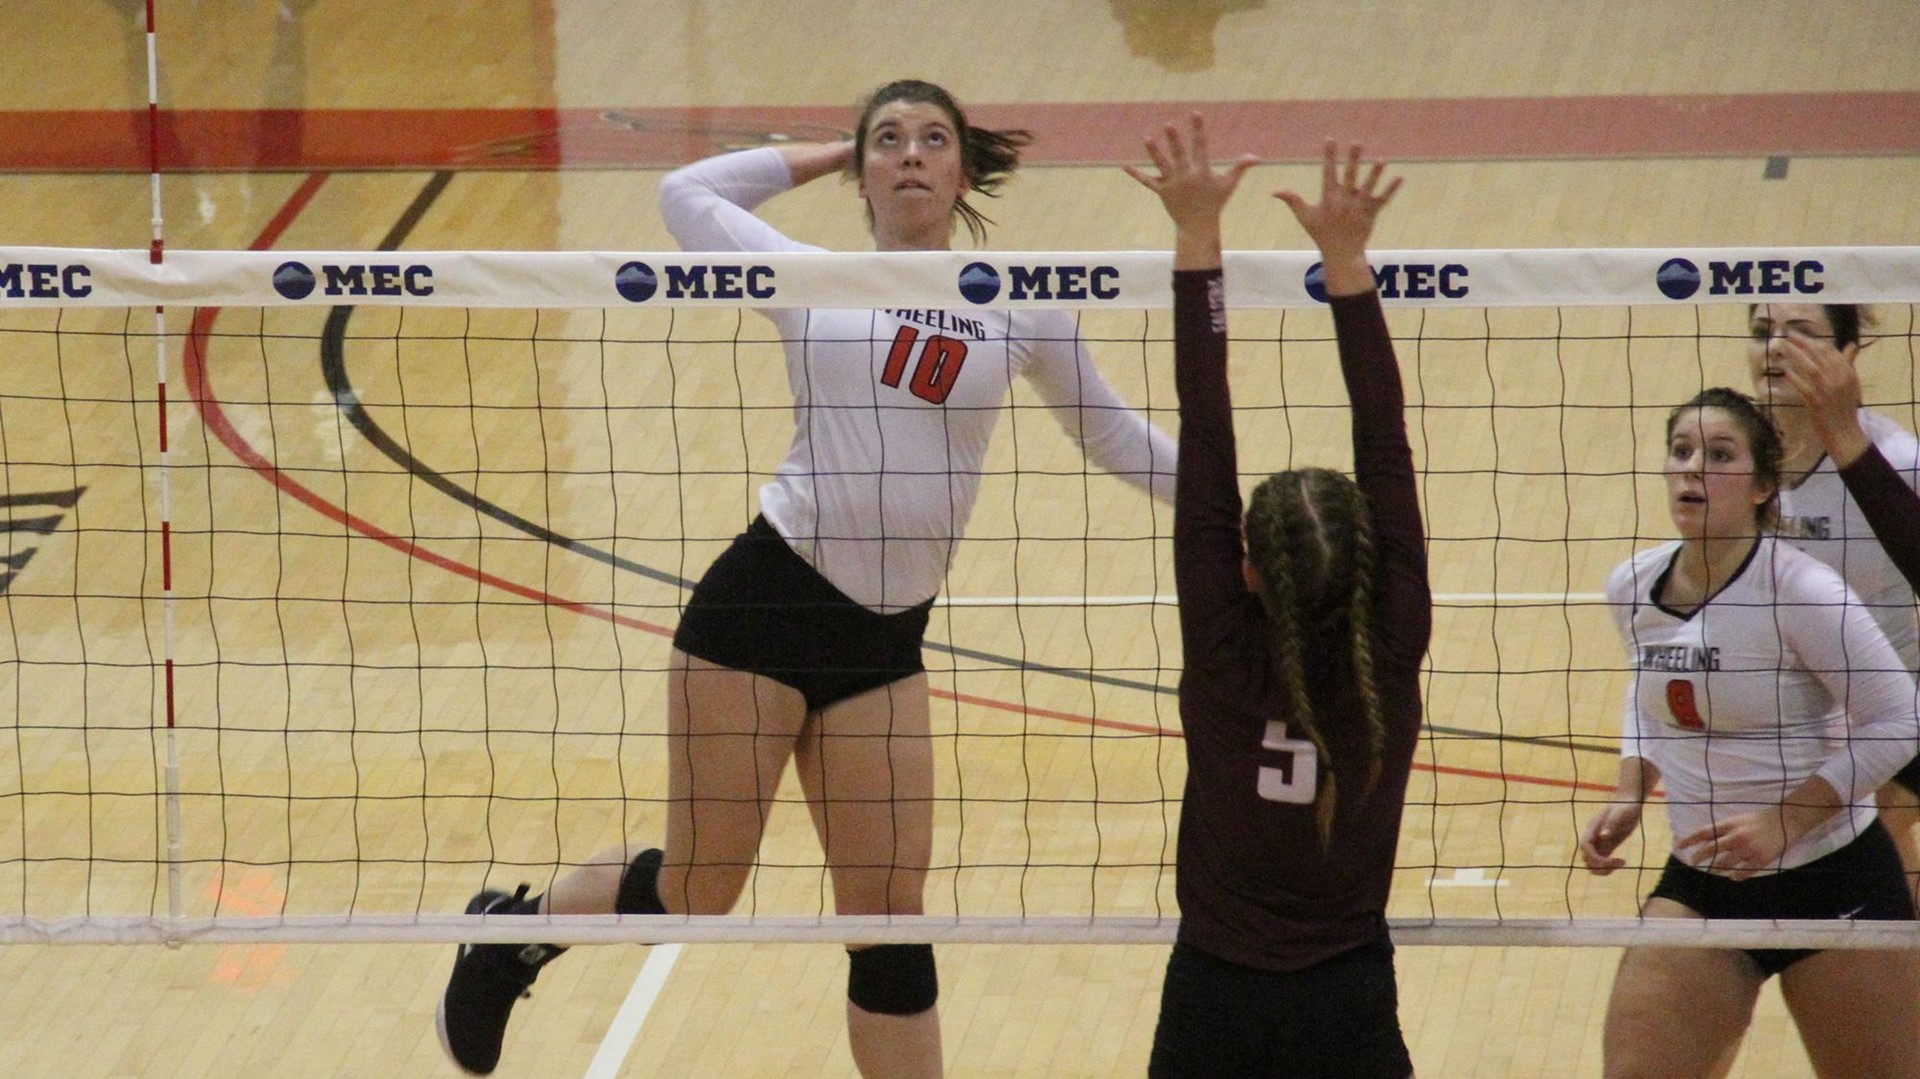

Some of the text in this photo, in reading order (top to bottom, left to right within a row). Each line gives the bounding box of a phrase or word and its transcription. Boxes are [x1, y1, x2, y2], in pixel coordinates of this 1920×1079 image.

[322, 265, 434, 296] MEC
[665, 265, 776, 298] MEC
[1008, 266, 1120, 300] MEC
[1368, 264, 1469, 298] MEC
[1709, 260, 1825, 295] MEC
[879, 309, 986, 341] HEELING
[881, 325, 968, 405] 10
[1257, 719, 1318, 804] 5
